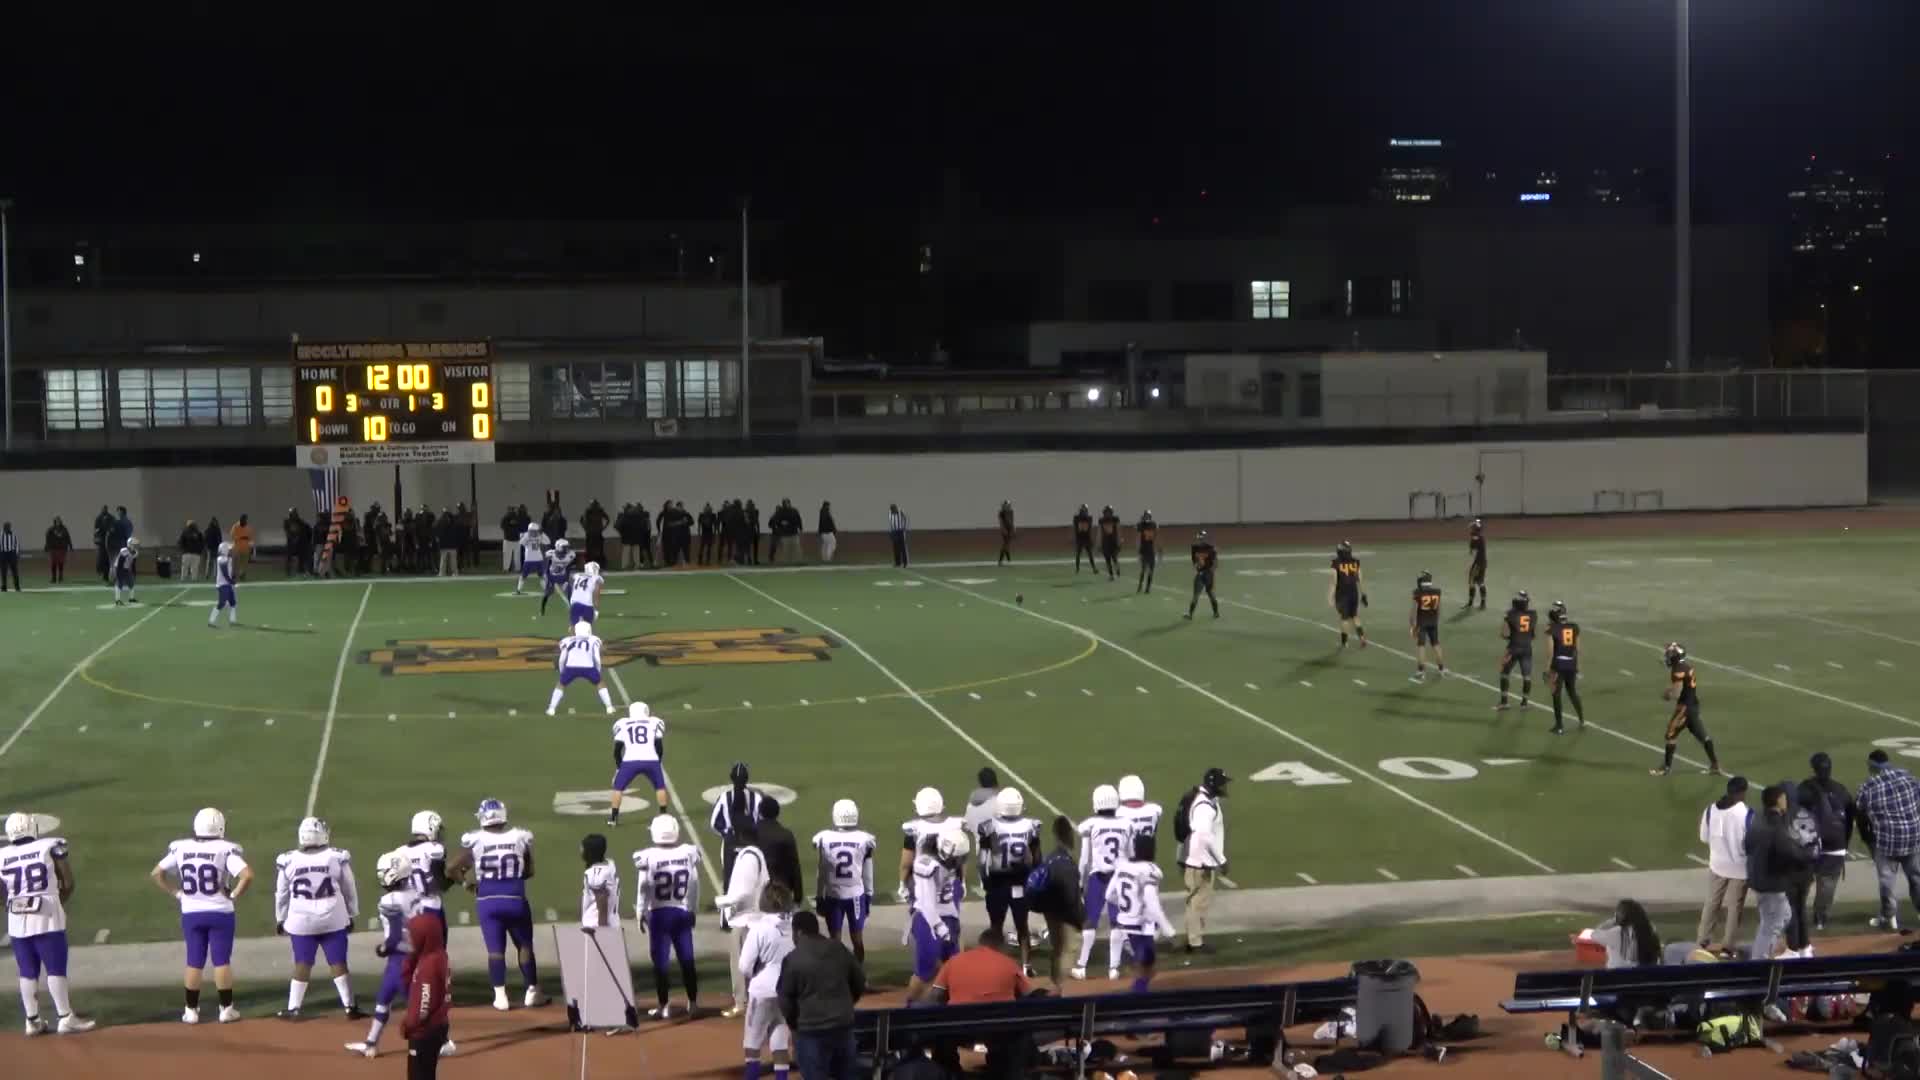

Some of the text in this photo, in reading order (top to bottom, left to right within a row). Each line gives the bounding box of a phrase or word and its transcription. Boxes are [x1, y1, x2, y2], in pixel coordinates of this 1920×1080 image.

[301, 368, 337, 381] HOME
[444, 365, 488, 378] VISITOR
[315, 385, 333, 412] 0
[345, 393, 358, 412] 3
[432, 392, 444, 410] 3
[471, 382, 489, 408] 0
[319, 423, 349, 435] DOWN
[363, 416, 387, 441] 10
[441, 413, 489, 439] ON 0
[1340, 563, 1358, 577] 44
[574, 577, 589, 592] 14
[1421, 594, 1440, 611] 27
[1519, 615, 1531, 633] 5
[1562, 627, 1575, 647] 8
[627, 725, 649, 745] 18
[1103, 836, 1120, 865] 3
[480, 853, 521, 880] 50
[835, 850, 853, 879] 2
[1, 862, 48, 897] 78
[181, 863, 218, 897] 68
[293, 876, 337, 900] 64
[653, 869, 690, 901] 28
[1119, 881, 1132, 913] 5
